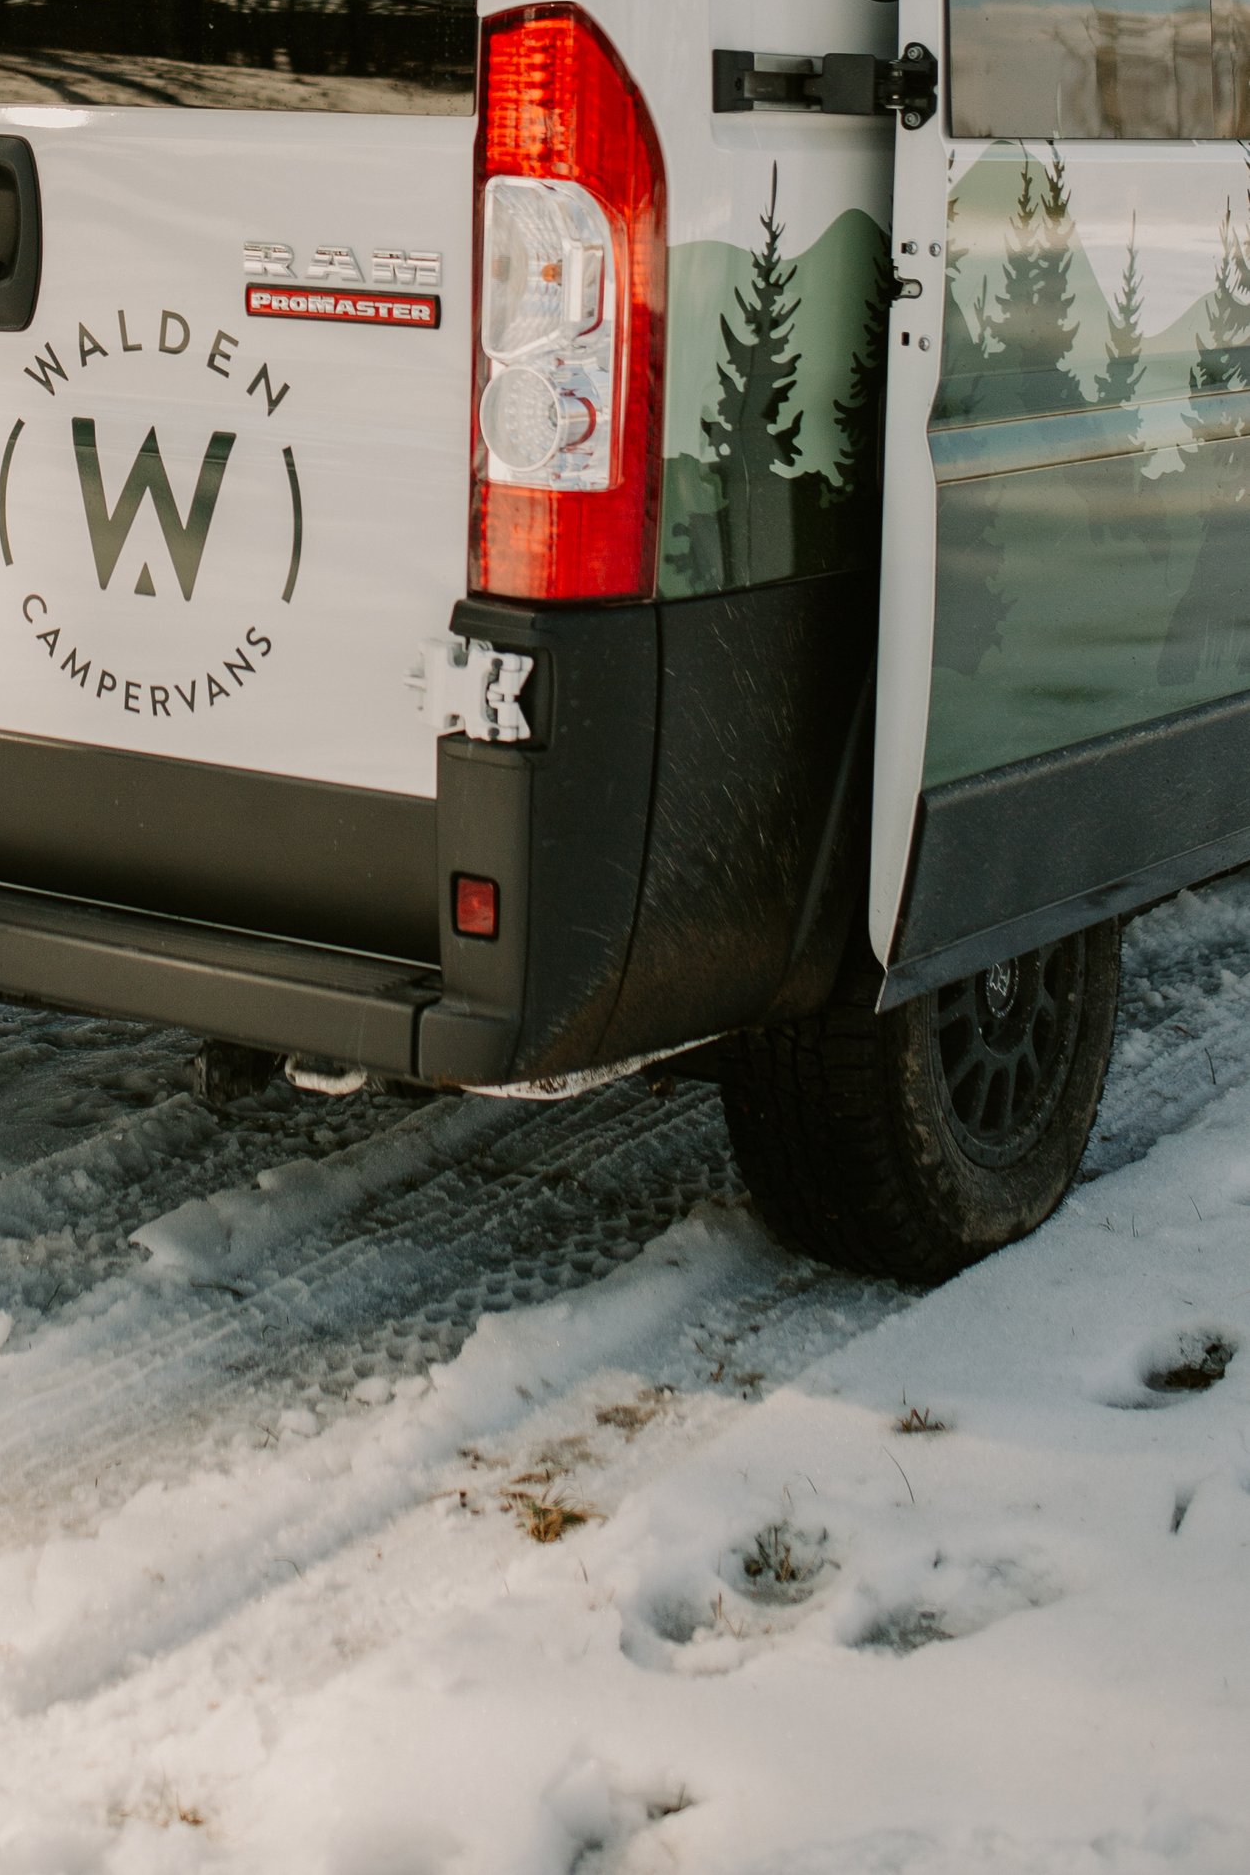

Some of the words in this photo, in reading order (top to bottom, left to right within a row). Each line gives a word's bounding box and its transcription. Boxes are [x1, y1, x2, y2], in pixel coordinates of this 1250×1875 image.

[243, 241, 441, 286] RAM
[23, 309, 291, 417] WALDEN
[72, 417, 237, 602] W
[22, 593, 272, 717] CAMPERVANS
